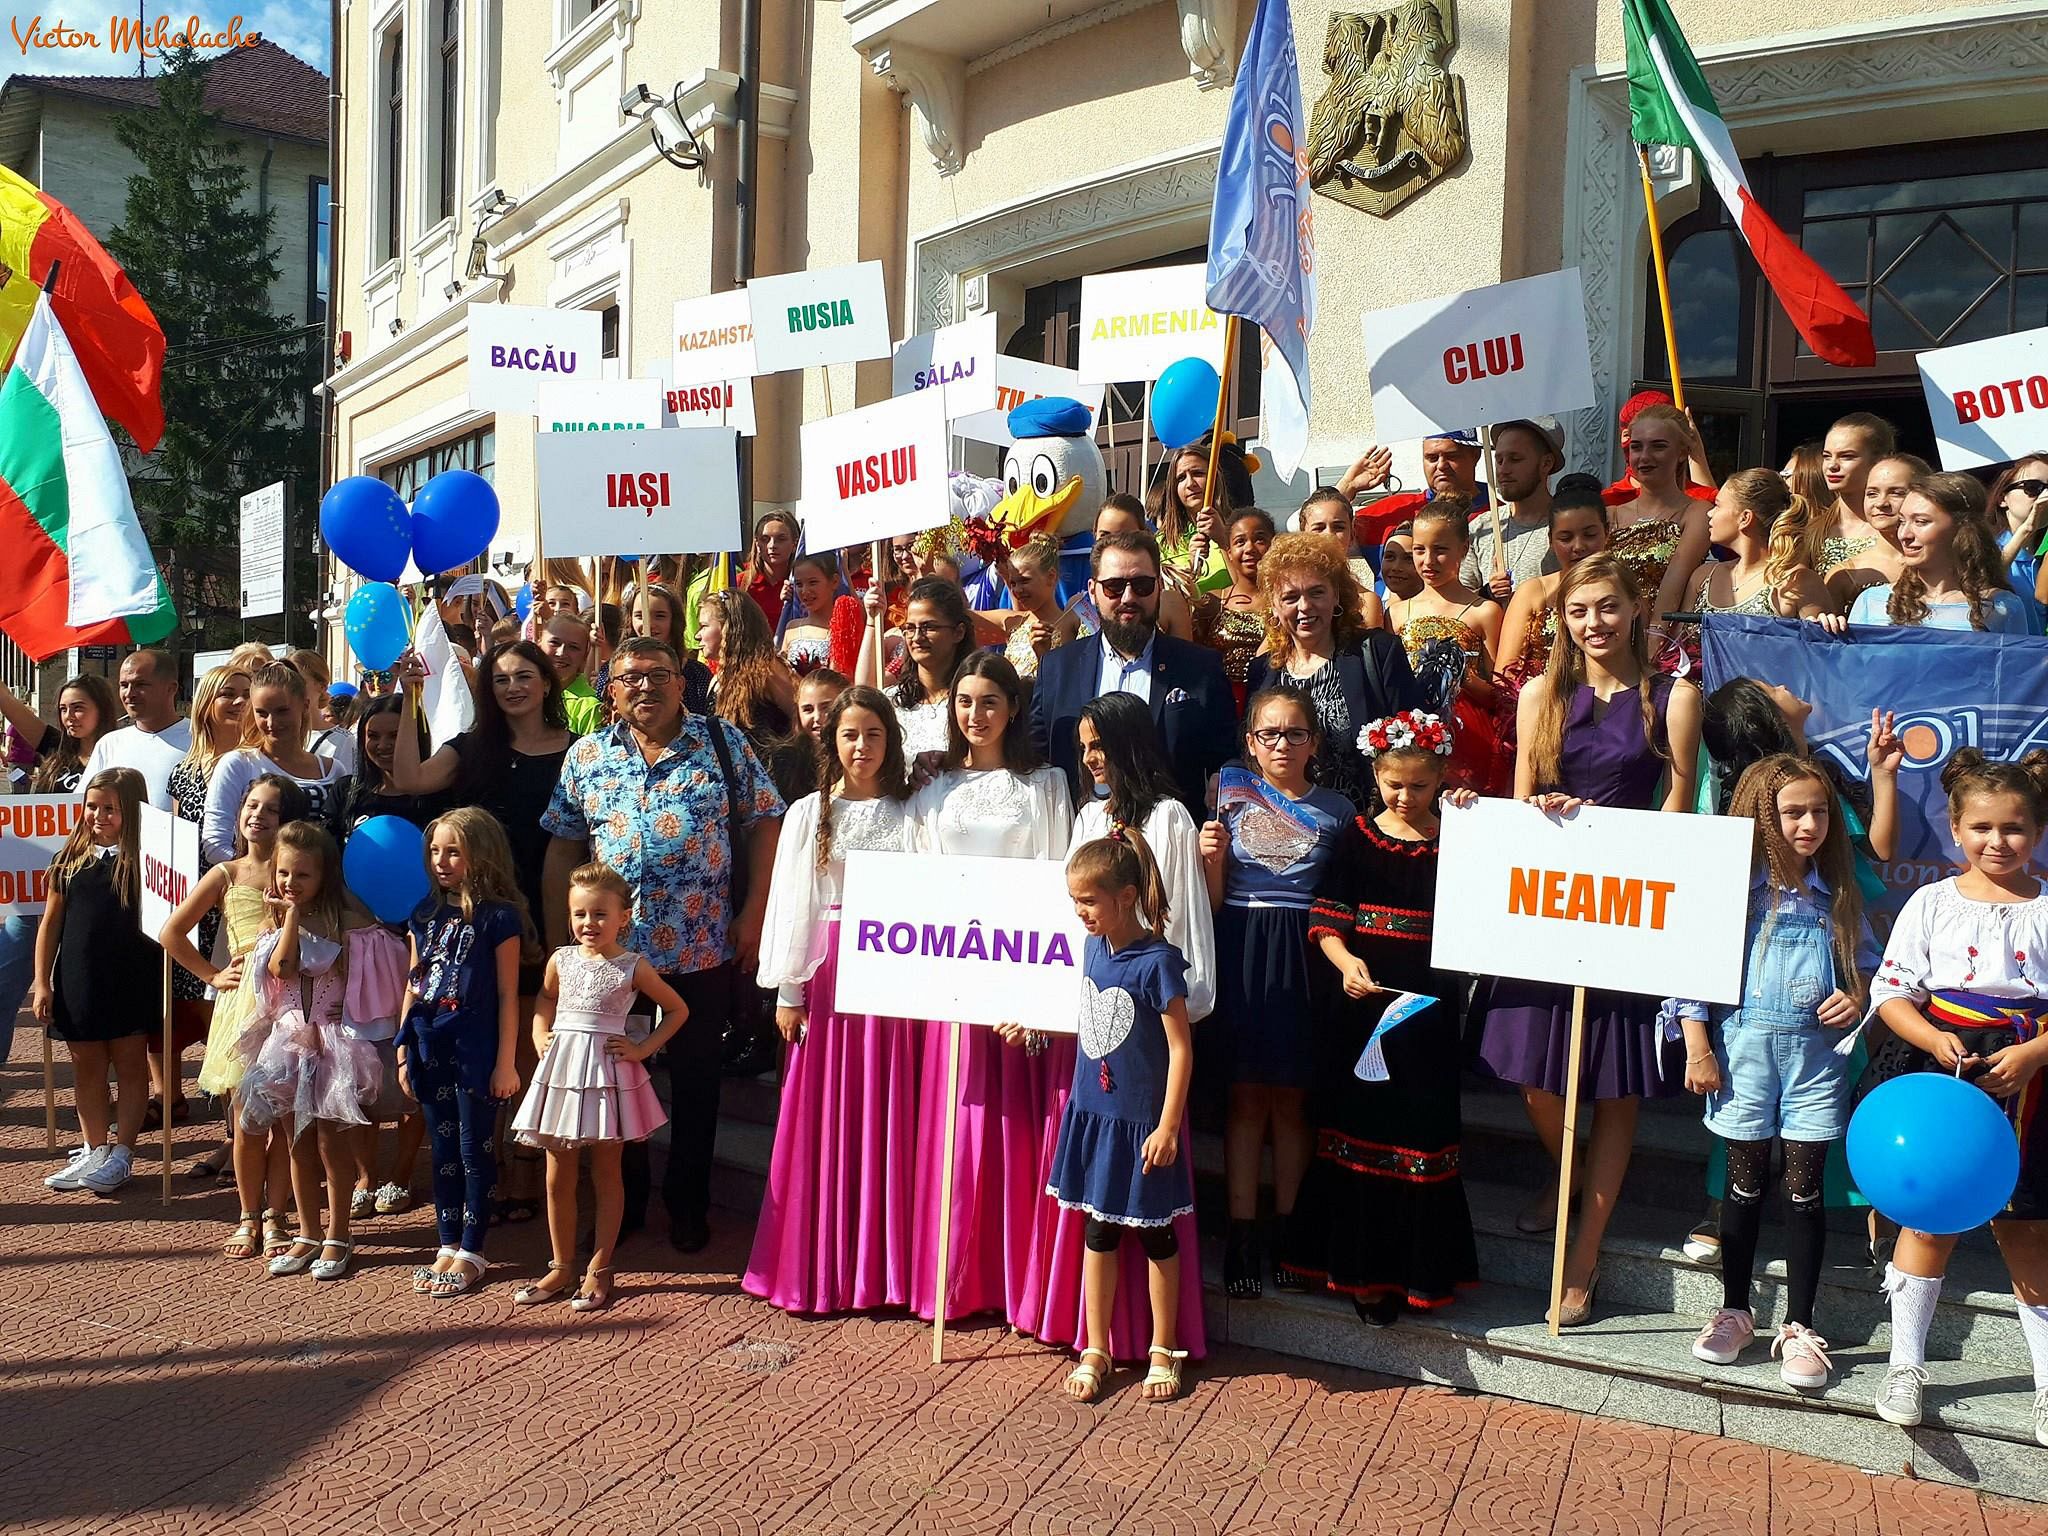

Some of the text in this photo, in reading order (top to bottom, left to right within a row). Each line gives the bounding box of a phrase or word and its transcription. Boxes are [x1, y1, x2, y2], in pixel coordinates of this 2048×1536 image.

[787, 299, 854, 333] RUSIA
[1090, 308, 1218, 341] ARMENIA
[491, 344, 577, 374] BACĂU
[914, 356, 976, 391] SĂLAJ
[1443, 333, 1524, 385] CLUJ
[1953, 375, 2048, 425] BOTO
[606, 472, 671, 518] IAȘI
[835, 444, 917, 500] VASLUI
[1508, 867, 1676, 931] NEAMT
[857, 919, 1075, 967] ROMÂNIA
